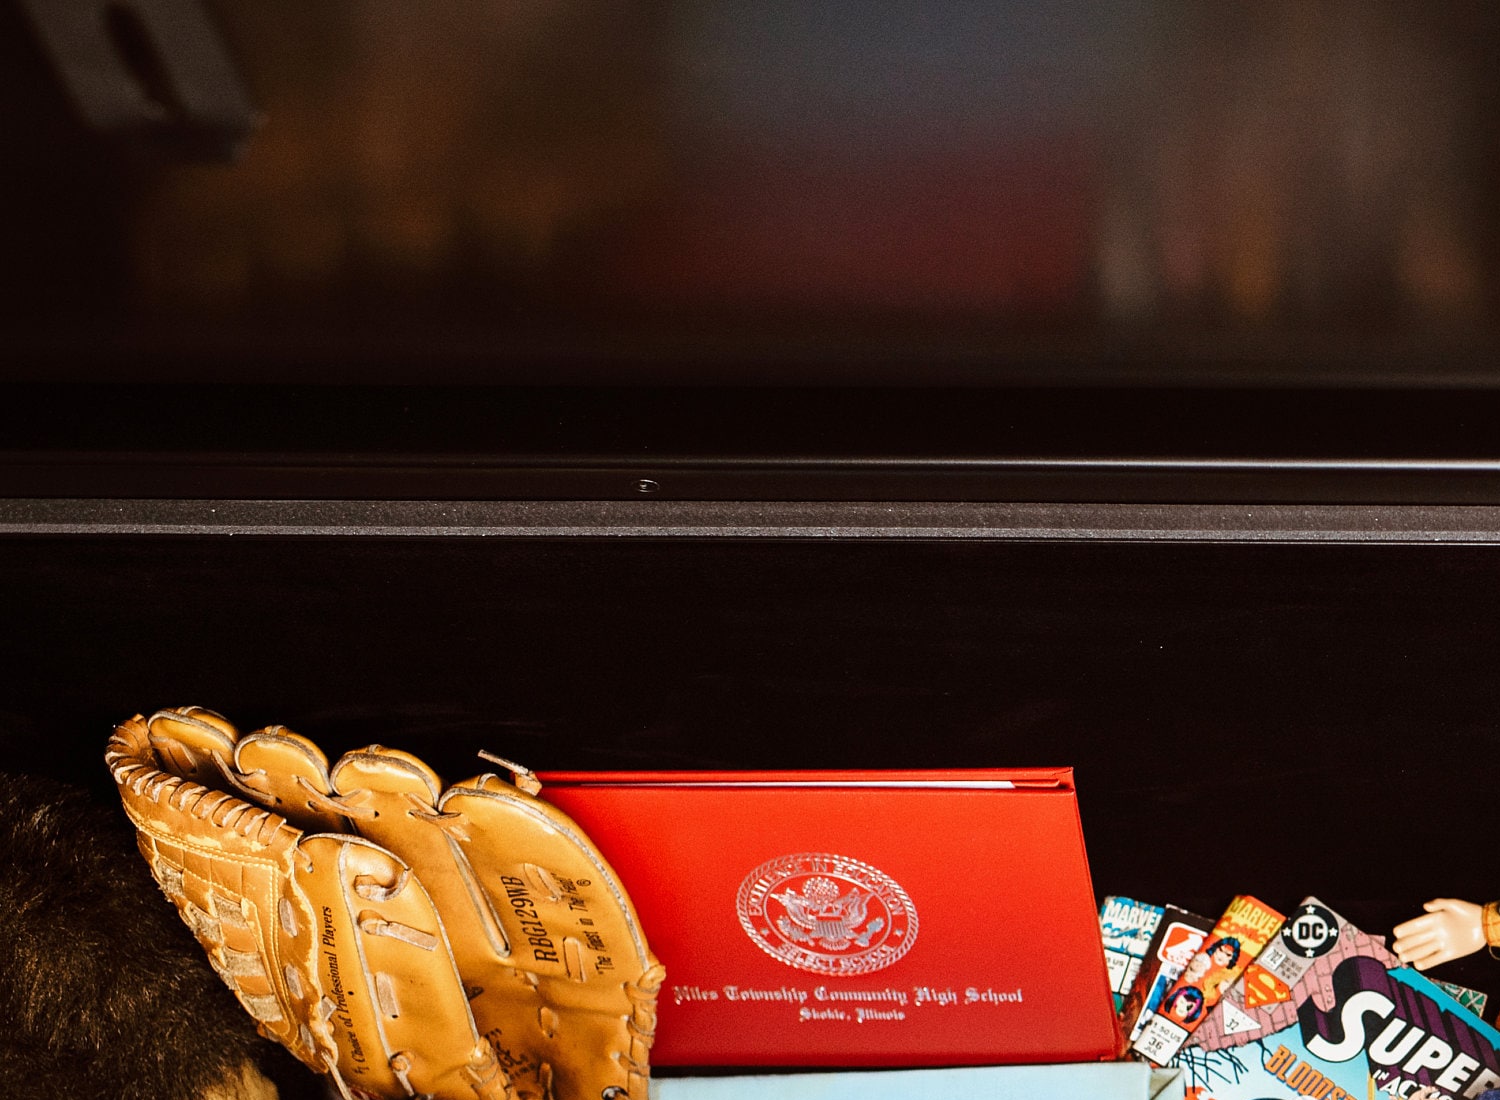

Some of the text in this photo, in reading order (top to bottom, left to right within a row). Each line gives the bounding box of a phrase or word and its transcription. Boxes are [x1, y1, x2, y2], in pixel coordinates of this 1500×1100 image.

[811, 859, 828, 872] IN
[833, 861, 904, 916] EDUCATION
[322, 905, 337, 948] Players
[501, 876, 559, 963] RBG129WB
[1298, 922, 1324, 940] DC
[323, 951, 350, 1014] Professional
[723, 985, 808, 1004] Township
[814, 986, 908, 1006] Community
[913, 986, 957, 1006] High
[964, 986, 1023, 1006] School
[337, 1015, 353, 1028] of
[855, 1007, 905, 1024] Illinois
[1147, 1034, 1164, 1051] 36
[1371, 1069, 1390, 1082] IN
